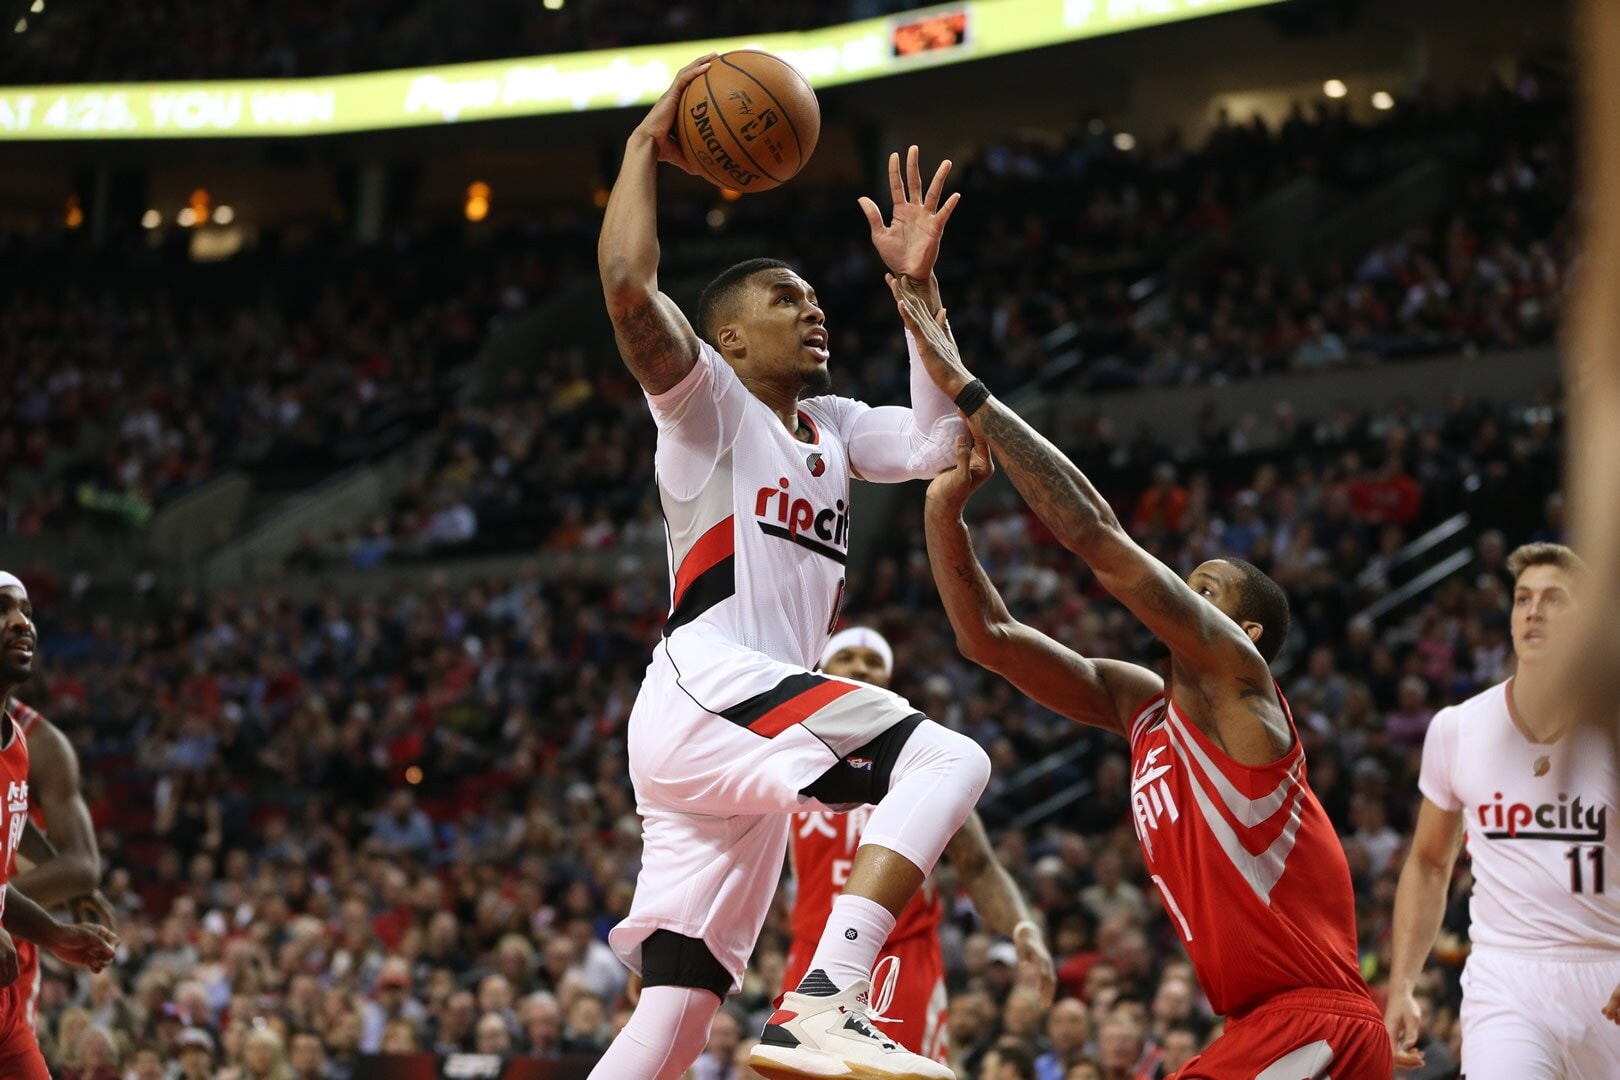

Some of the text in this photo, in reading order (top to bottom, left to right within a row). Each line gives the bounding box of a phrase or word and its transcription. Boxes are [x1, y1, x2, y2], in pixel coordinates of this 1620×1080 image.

[150, 90, 243, 129] YOU
[690, 100, 760, 186] SPALDING
[1478, 791, 1607, 842] ripcity
[1564, 845, 1605, 895] 11
